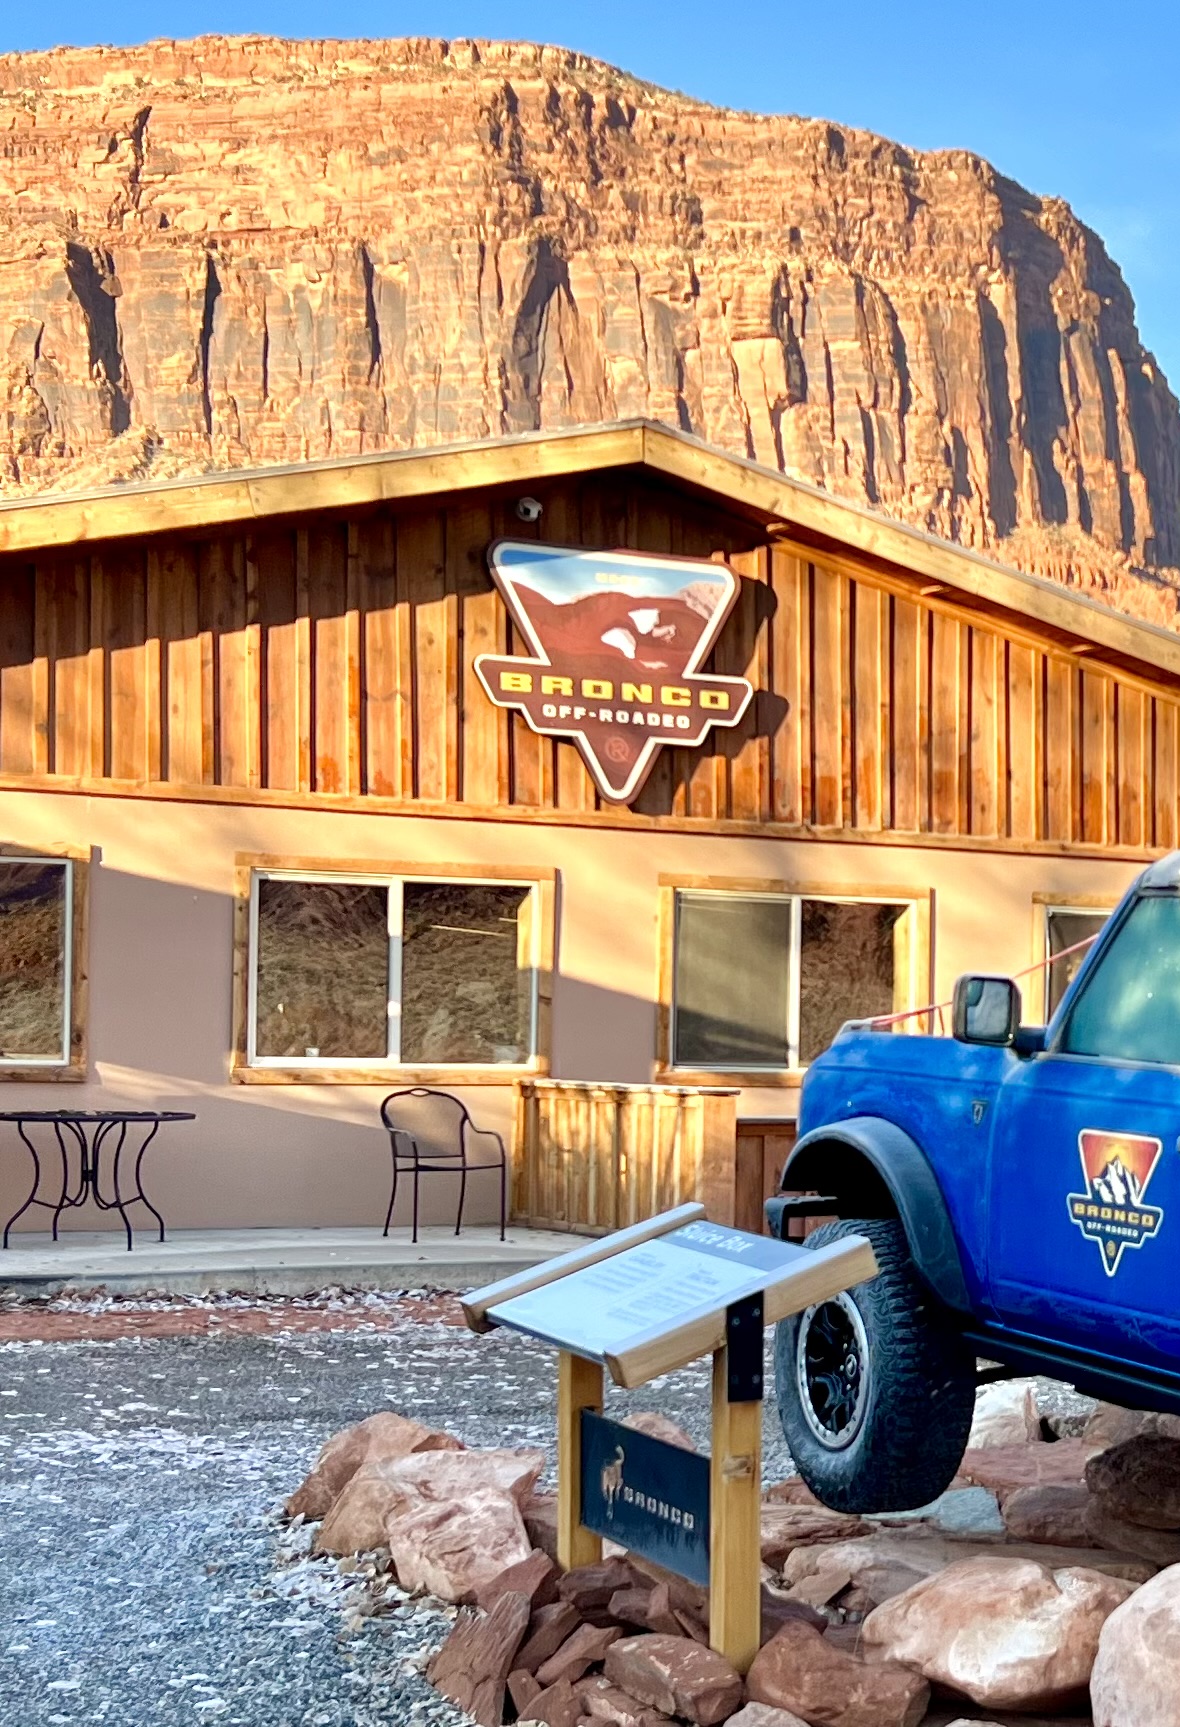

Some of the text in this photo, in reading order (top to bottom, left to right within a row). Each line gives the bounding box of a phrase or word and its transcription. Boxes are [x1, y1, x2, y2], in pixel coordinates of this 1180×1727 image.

[500, 671, 730, 711] BRONCO
[542, 704, 691, 729] OFF-ROADEO
[1073, 1202, 1155, 1228] BRONCO
[623, 1485, 695, 1530] BRONCO
